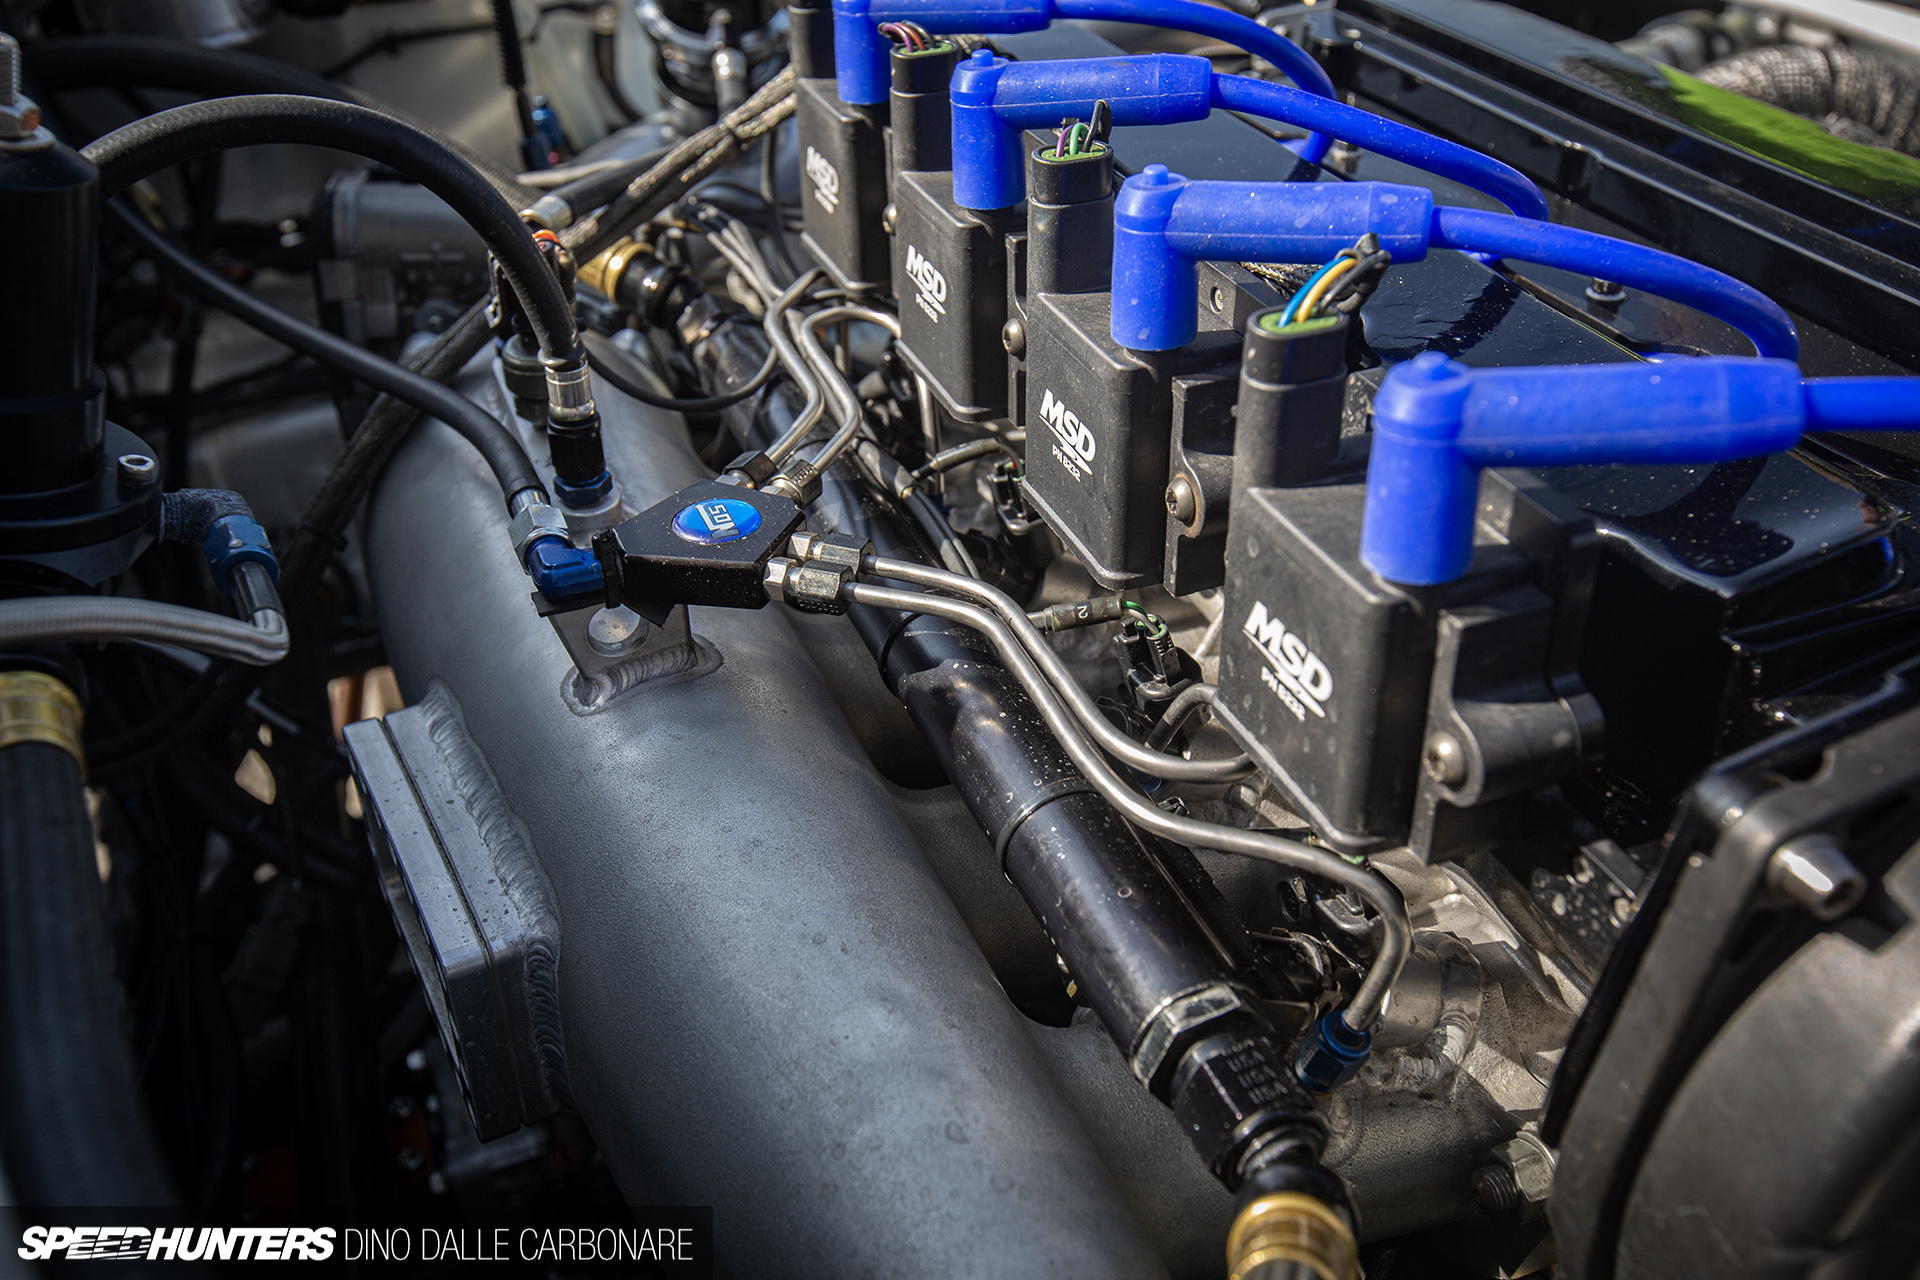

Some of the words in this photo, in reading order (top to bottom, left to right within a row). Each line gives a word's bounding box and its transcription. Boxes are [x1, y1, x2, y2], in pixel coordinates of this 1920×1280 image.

[805, 145, 840, 196] MSD
[905, 244, 947, 303] MSD
[1039, 388, 1096, 462] MSD
[1052, 443, 1063, 464] PN
[1062, 455, 1081, 483] 8232
[694, 503, 741, 540] NOS
[1077, 605, 1089, 619] 2
[1243, 600, 1334, 702] MSD
